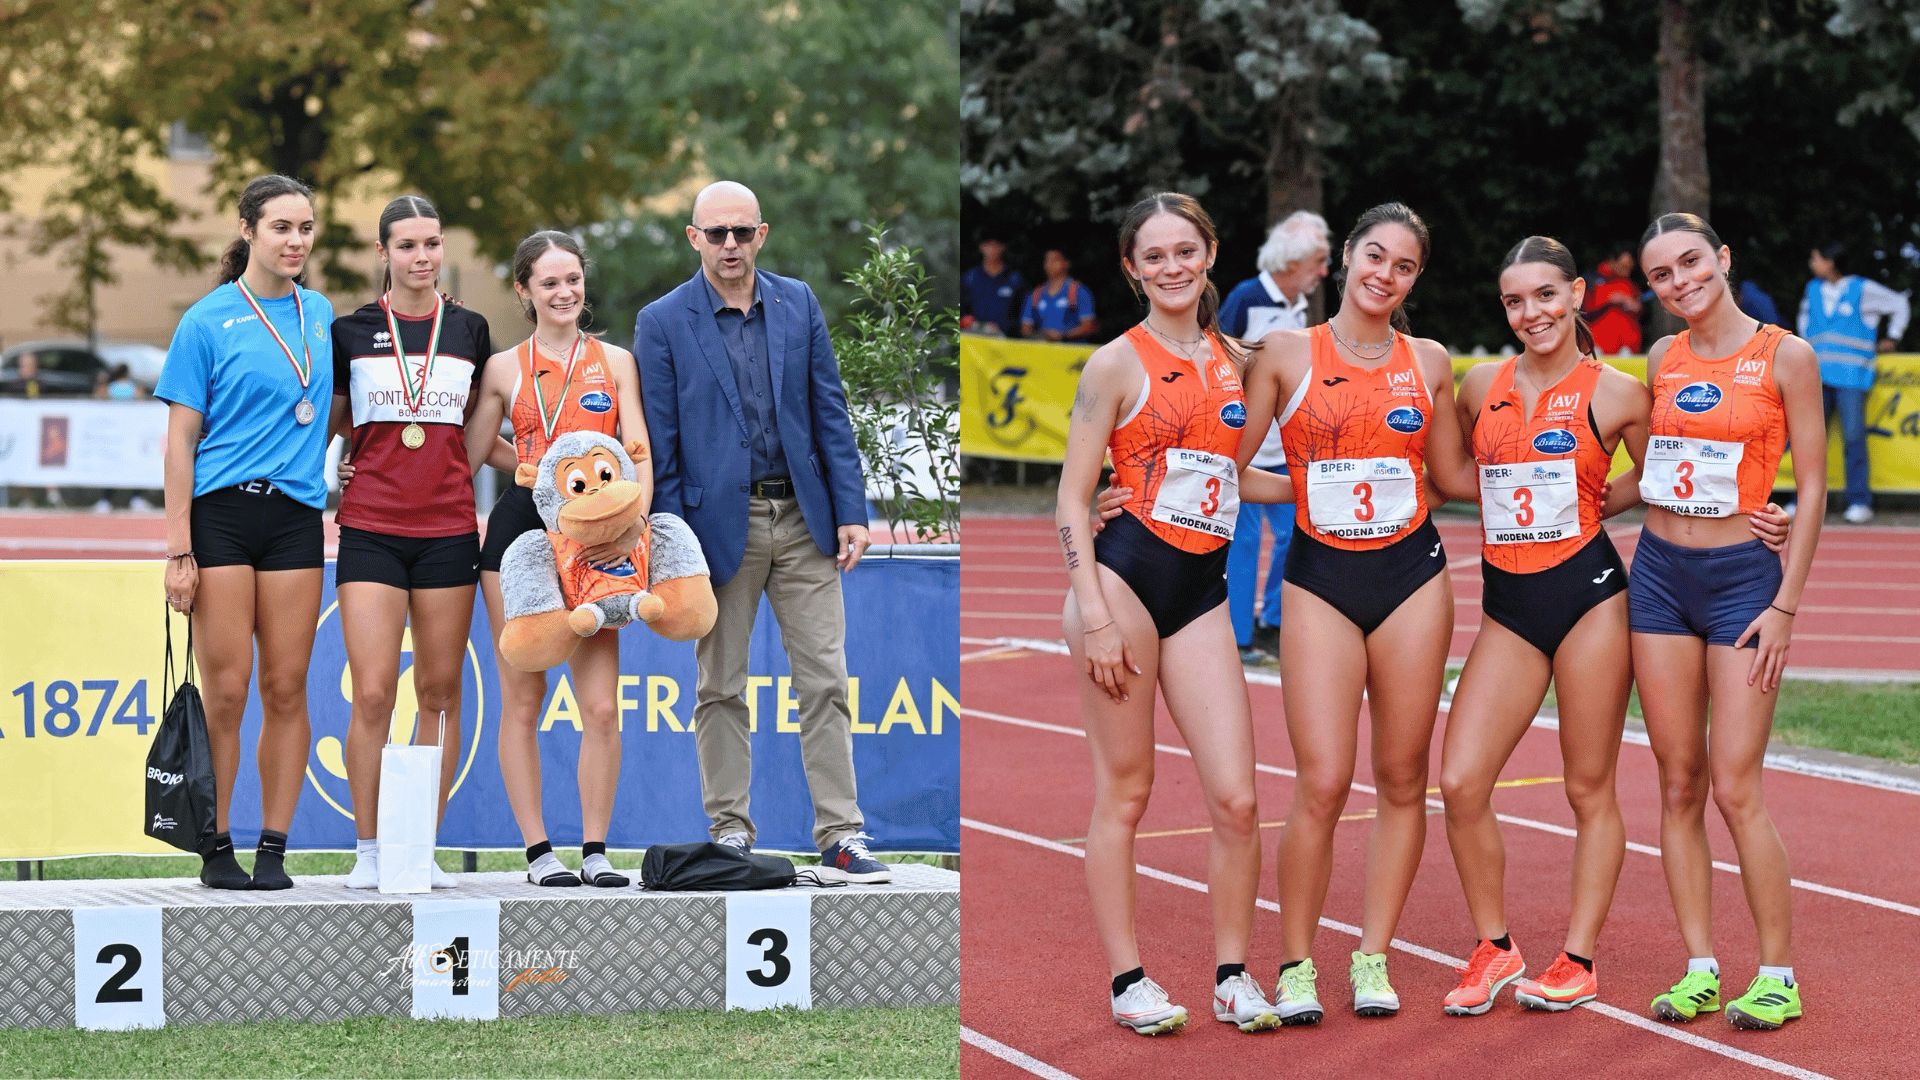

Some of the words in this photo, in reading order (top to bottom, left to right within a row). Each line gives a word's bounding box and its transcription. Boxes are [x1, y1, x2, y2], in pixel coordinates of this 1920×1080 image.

[368, 391, 466, 409] PONTEECCHIO
[1200, 477, 1221, 517] 3
[1673, 460, 1695, 500] 3
[1352, 481, 1375, 523] 3
[1513, 487, 1535, 527] 3
[1693, 506, 1720, 515] 2025
[1170, 514, 1213, 532] MODENA
[1495, 532, 1536, 542] MODENA
[1537, 530, 1562, 540] 2025
[12, 679, 156, 738] 1874
[94, 943, 143, 1004] 2
[443, 936, 470, 996] 1
[746, 928, 791, 987] 3
